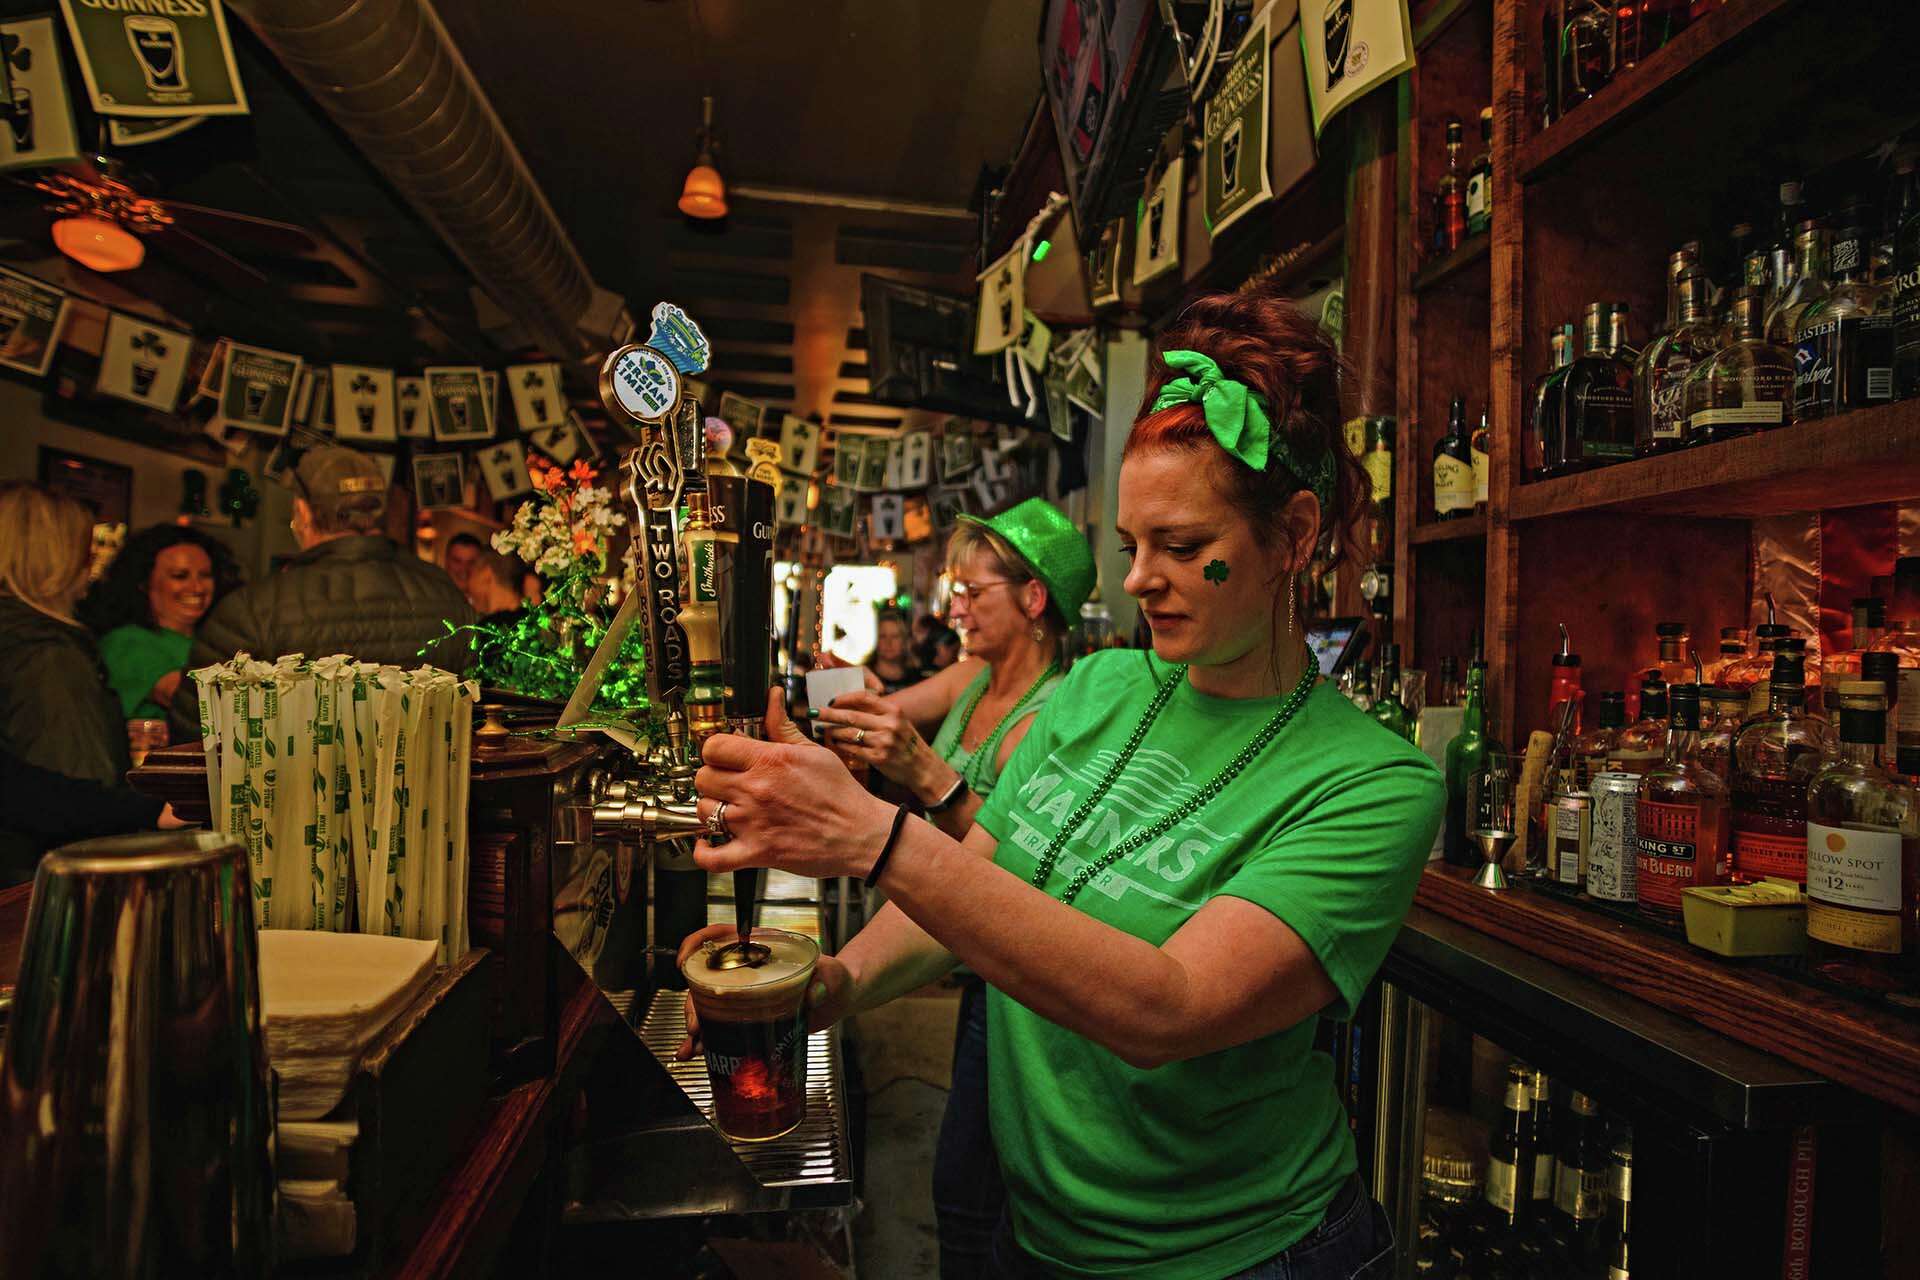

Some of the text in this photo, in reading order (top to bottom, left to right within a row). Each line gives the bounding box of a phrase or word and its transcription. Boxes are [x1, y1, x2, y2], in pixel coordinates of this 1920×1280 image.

[622, 354, 668, 407] PERSIAN
[632, 535, 645, 582] TWO
[650, 524, 684, 680] TWO ROADS
[1023, 834, 1067, 866] IRIH
[1637, 840, 1667, 854] KING
[1808, 849, 1844, 866] ELLOW
[1847, 856, 1882, 871] SPOT
[1649, 858, 1693, 878] BLEND
[1827, 876, 1844, 890] 12
[1792, 1167, 1811, 1251] BOROUGH
